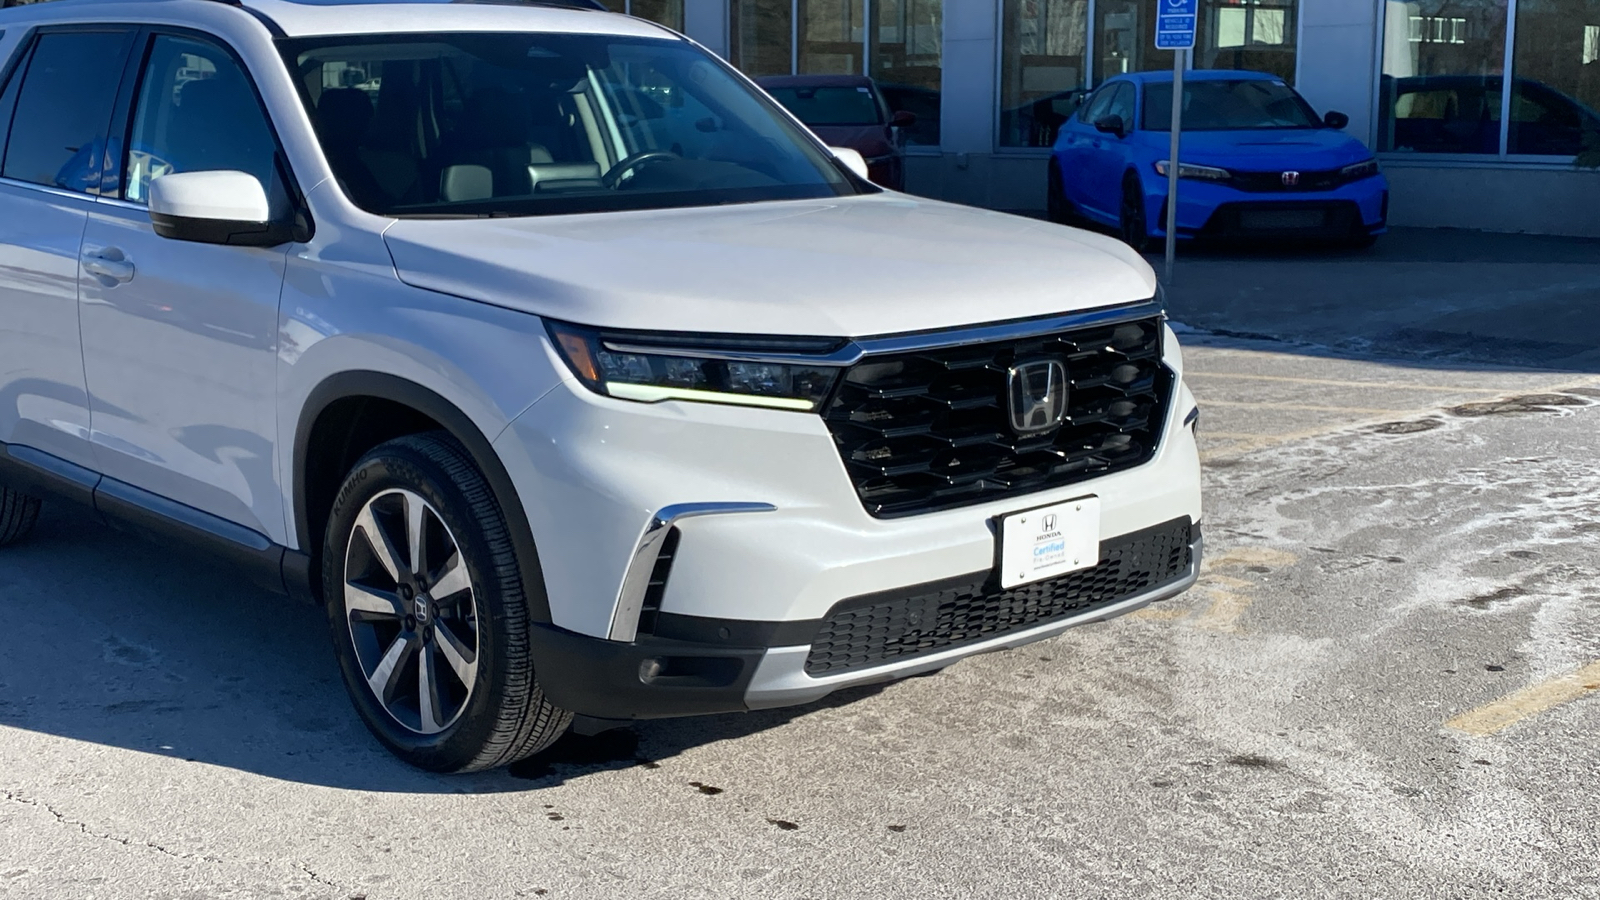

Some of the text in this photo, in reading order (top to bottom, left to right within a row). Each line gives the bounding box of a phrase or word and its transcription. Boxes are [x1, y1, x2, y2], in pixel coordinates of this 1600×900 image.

[333, 467, 368, 516] KUMHO
[1036, 531, 1062, 541] HONDA
[1033, 540, 1065, 556] Certified
